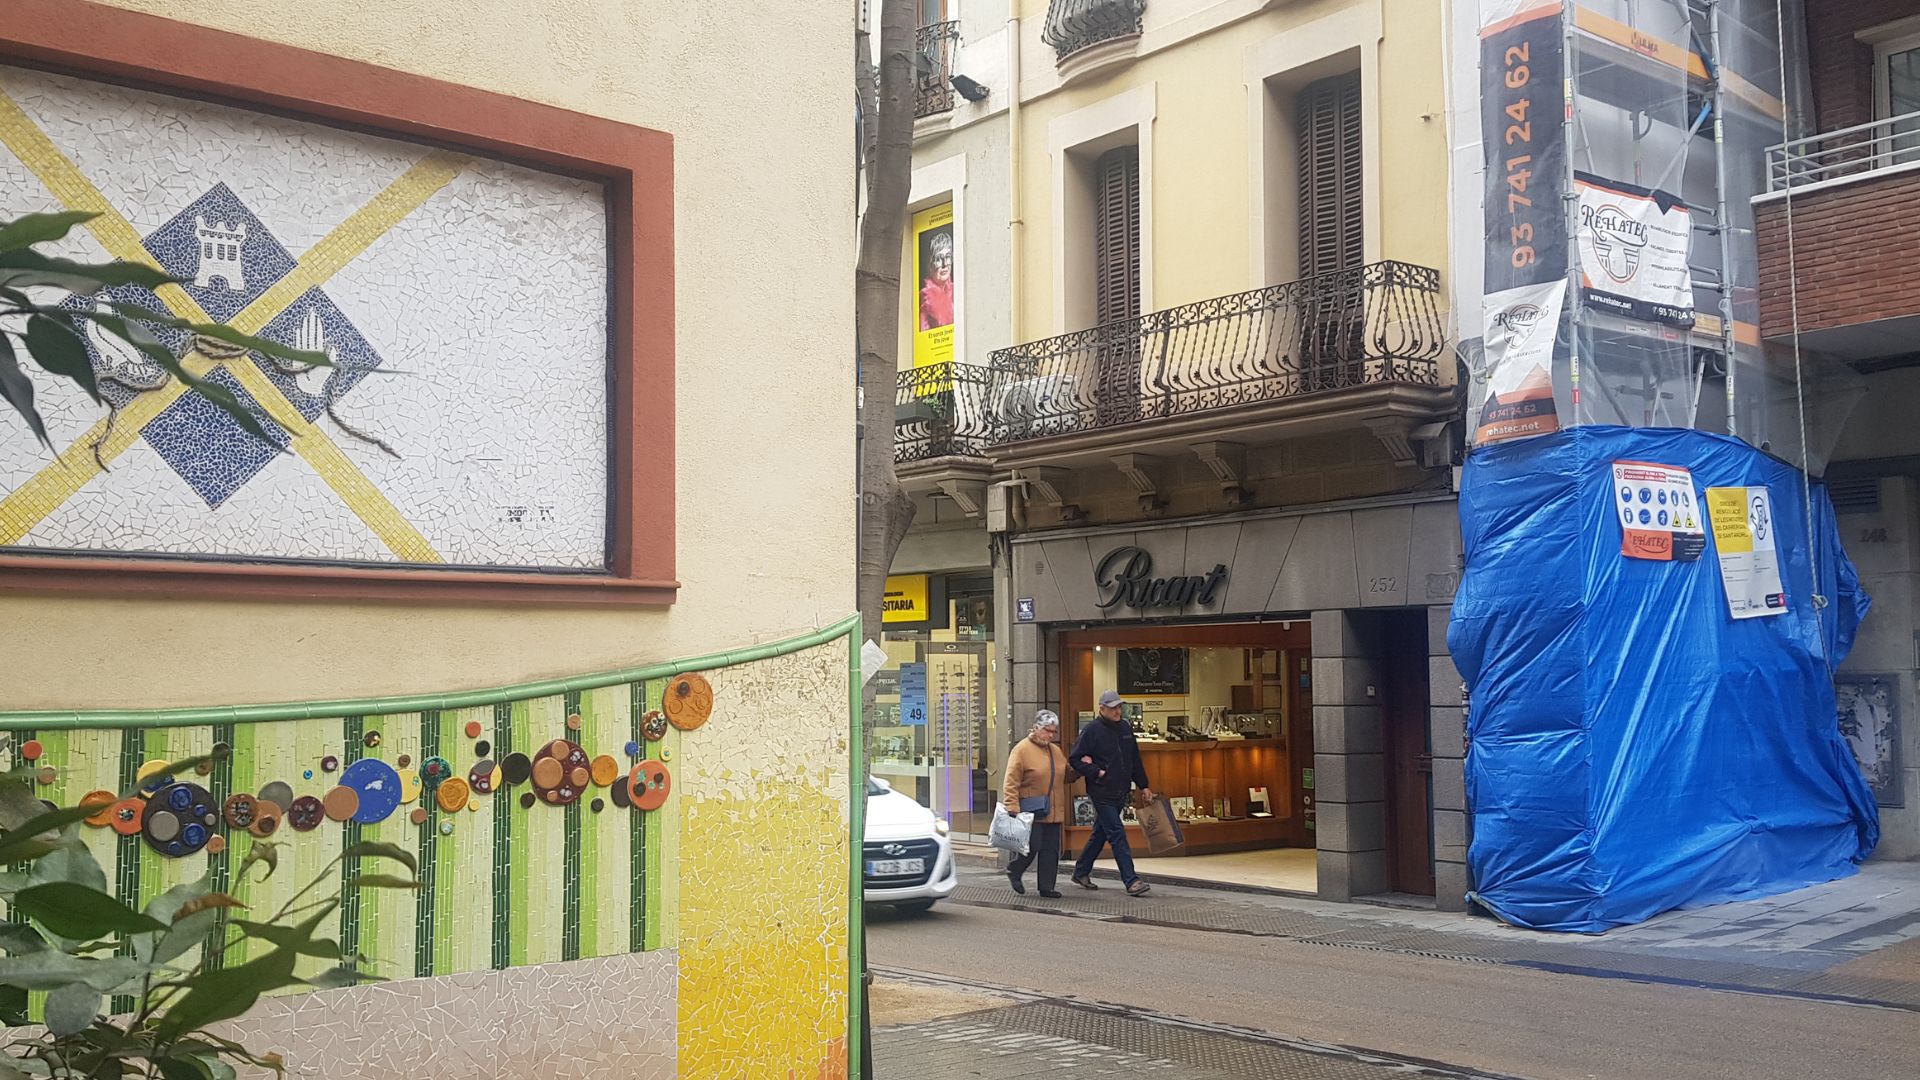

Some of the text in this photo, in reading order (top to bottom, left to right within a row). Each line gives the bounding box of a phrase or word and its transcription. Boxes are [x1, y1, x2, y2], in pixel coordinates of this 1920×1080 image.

[1504, 41, 1536, 270] 93 741 24 62
[1581, 204, 1648, 246] REHATEC
[1678, 310, 1688, 320] 24
[1524, 404, 1537, 414] 62
[1486, 421, 1540, 437] rehatec.net
[1095, 546, 1228, 609] Ricart
[1369, 577, 1397, 593] 252
